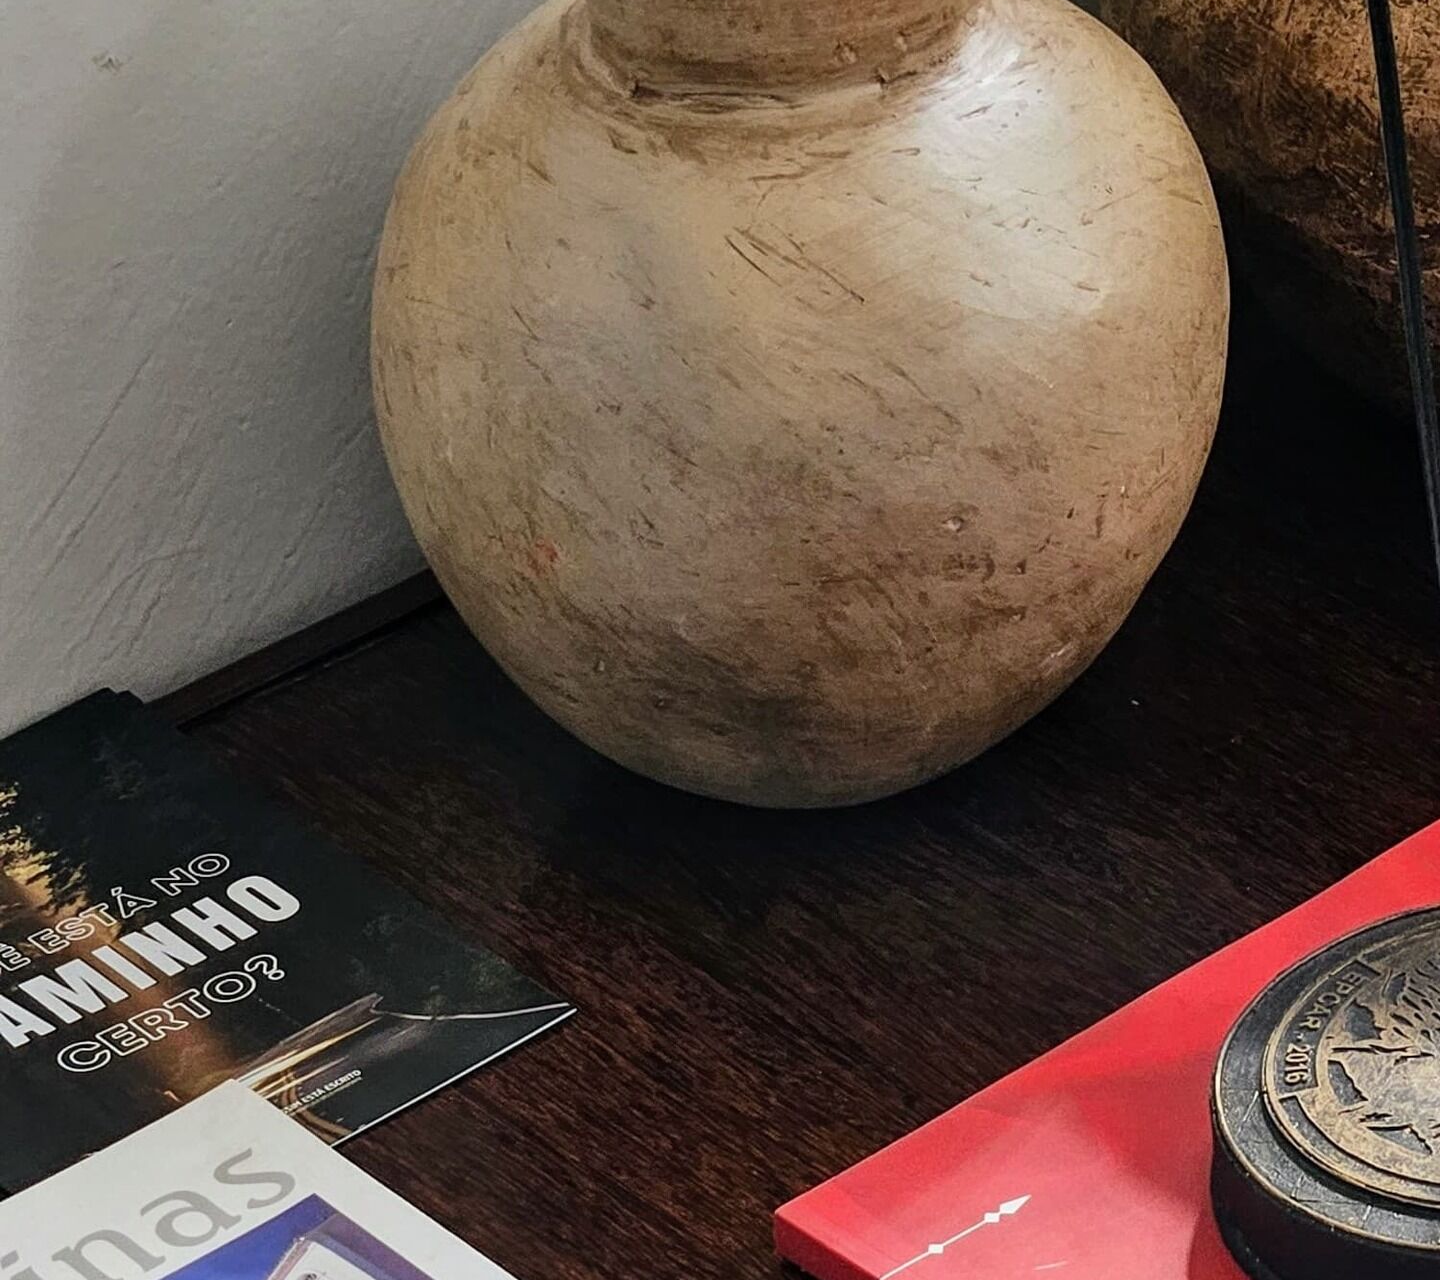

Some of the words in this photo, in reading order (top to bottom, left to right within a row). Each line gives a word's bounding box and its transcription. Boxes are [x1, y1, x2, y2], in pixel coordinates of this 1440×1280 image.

[27, 886, 158, 954] ESTÁ
[151, 853, 231, 896] NO
[56, 953, 286, 1073] CERTO?
[1299, 971, 1362, 1030] EPCAR
[1285, 1042, 1312, 1085] 2016
